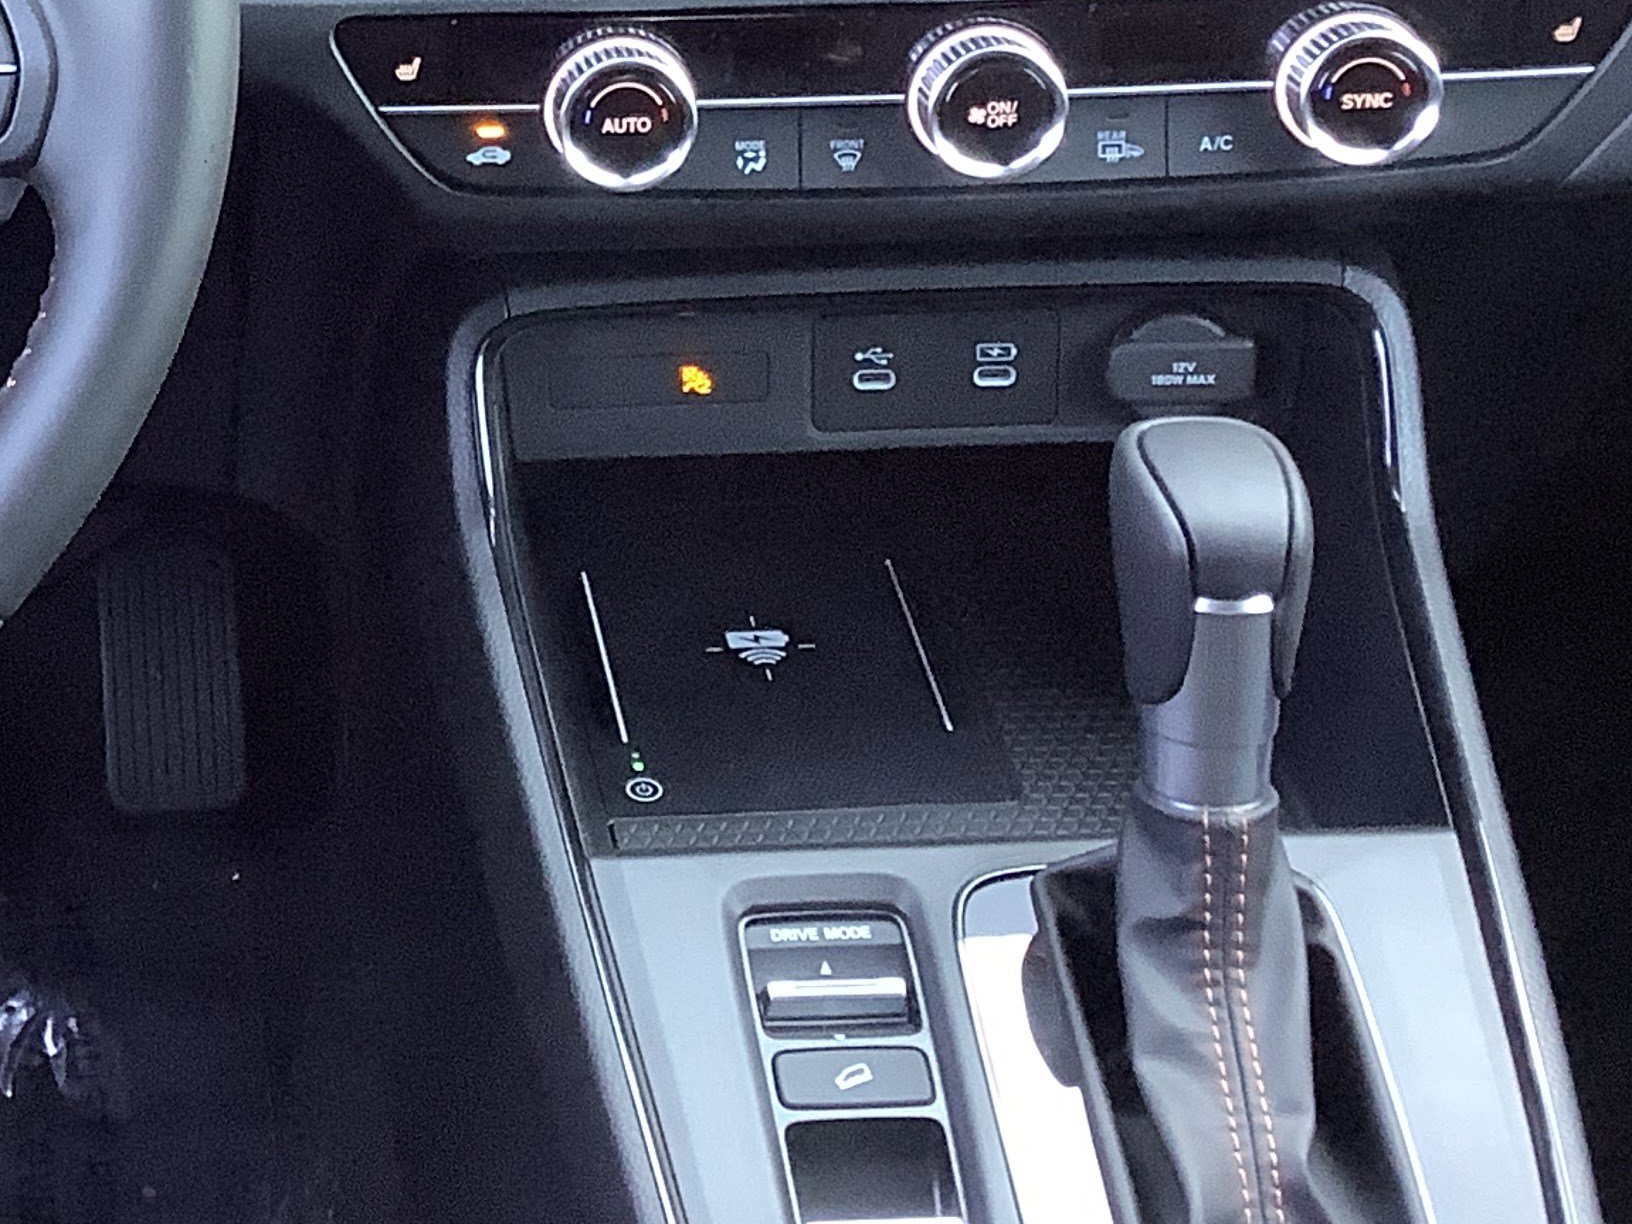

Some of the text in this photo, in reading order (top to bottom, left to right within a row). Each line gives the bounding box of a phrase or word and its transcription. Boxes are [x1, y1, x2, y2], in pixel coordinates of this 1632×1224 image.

[986, 99, 1019, 115] ON/
[1340, 92, 1395, 111] SYNC
[600, 116, 653, 136] AUTO
[986, 113, 1019, 128] OFF
[1198, 134, 1234, 153] A/C
[1171, 361, 1197, 374] 12V
[1186, 373, 1217, 385] MAX
[770, 924, 872, 943] DRIVE MODE
